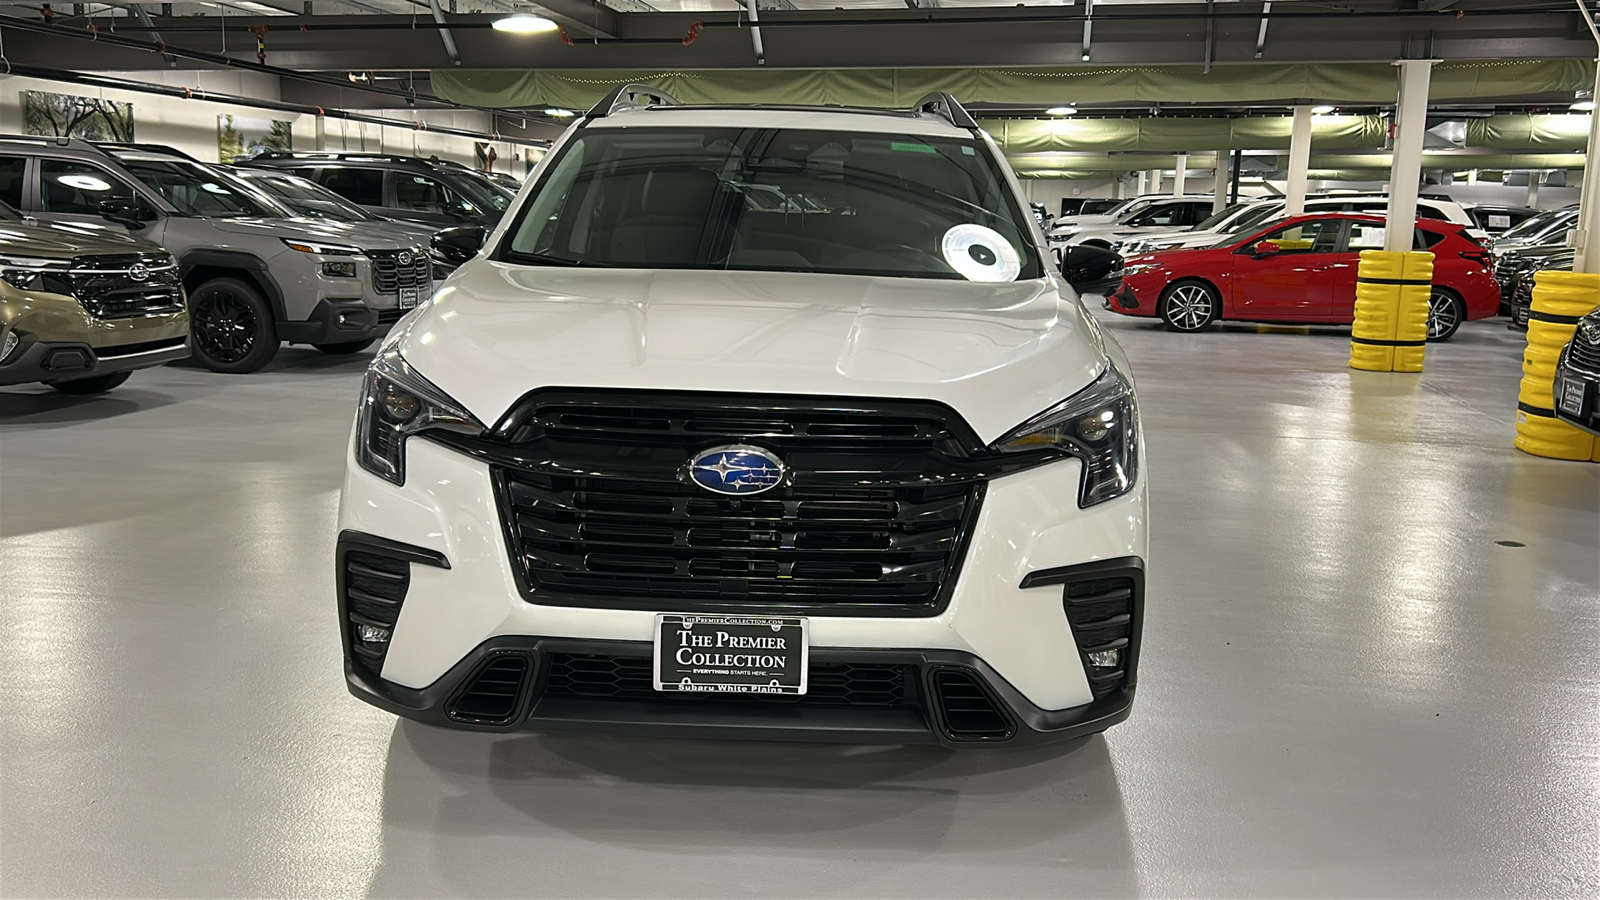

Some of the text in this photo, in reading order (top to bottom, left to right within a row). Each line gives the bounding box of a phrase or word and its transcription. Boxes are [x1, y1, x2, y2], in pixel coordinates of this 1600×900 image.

[676, 630, 787, 649] THE PREMIER
[675, 648, 787, 668] COLLECTION
[678, 683, 783, 694] Subaru White Plains
